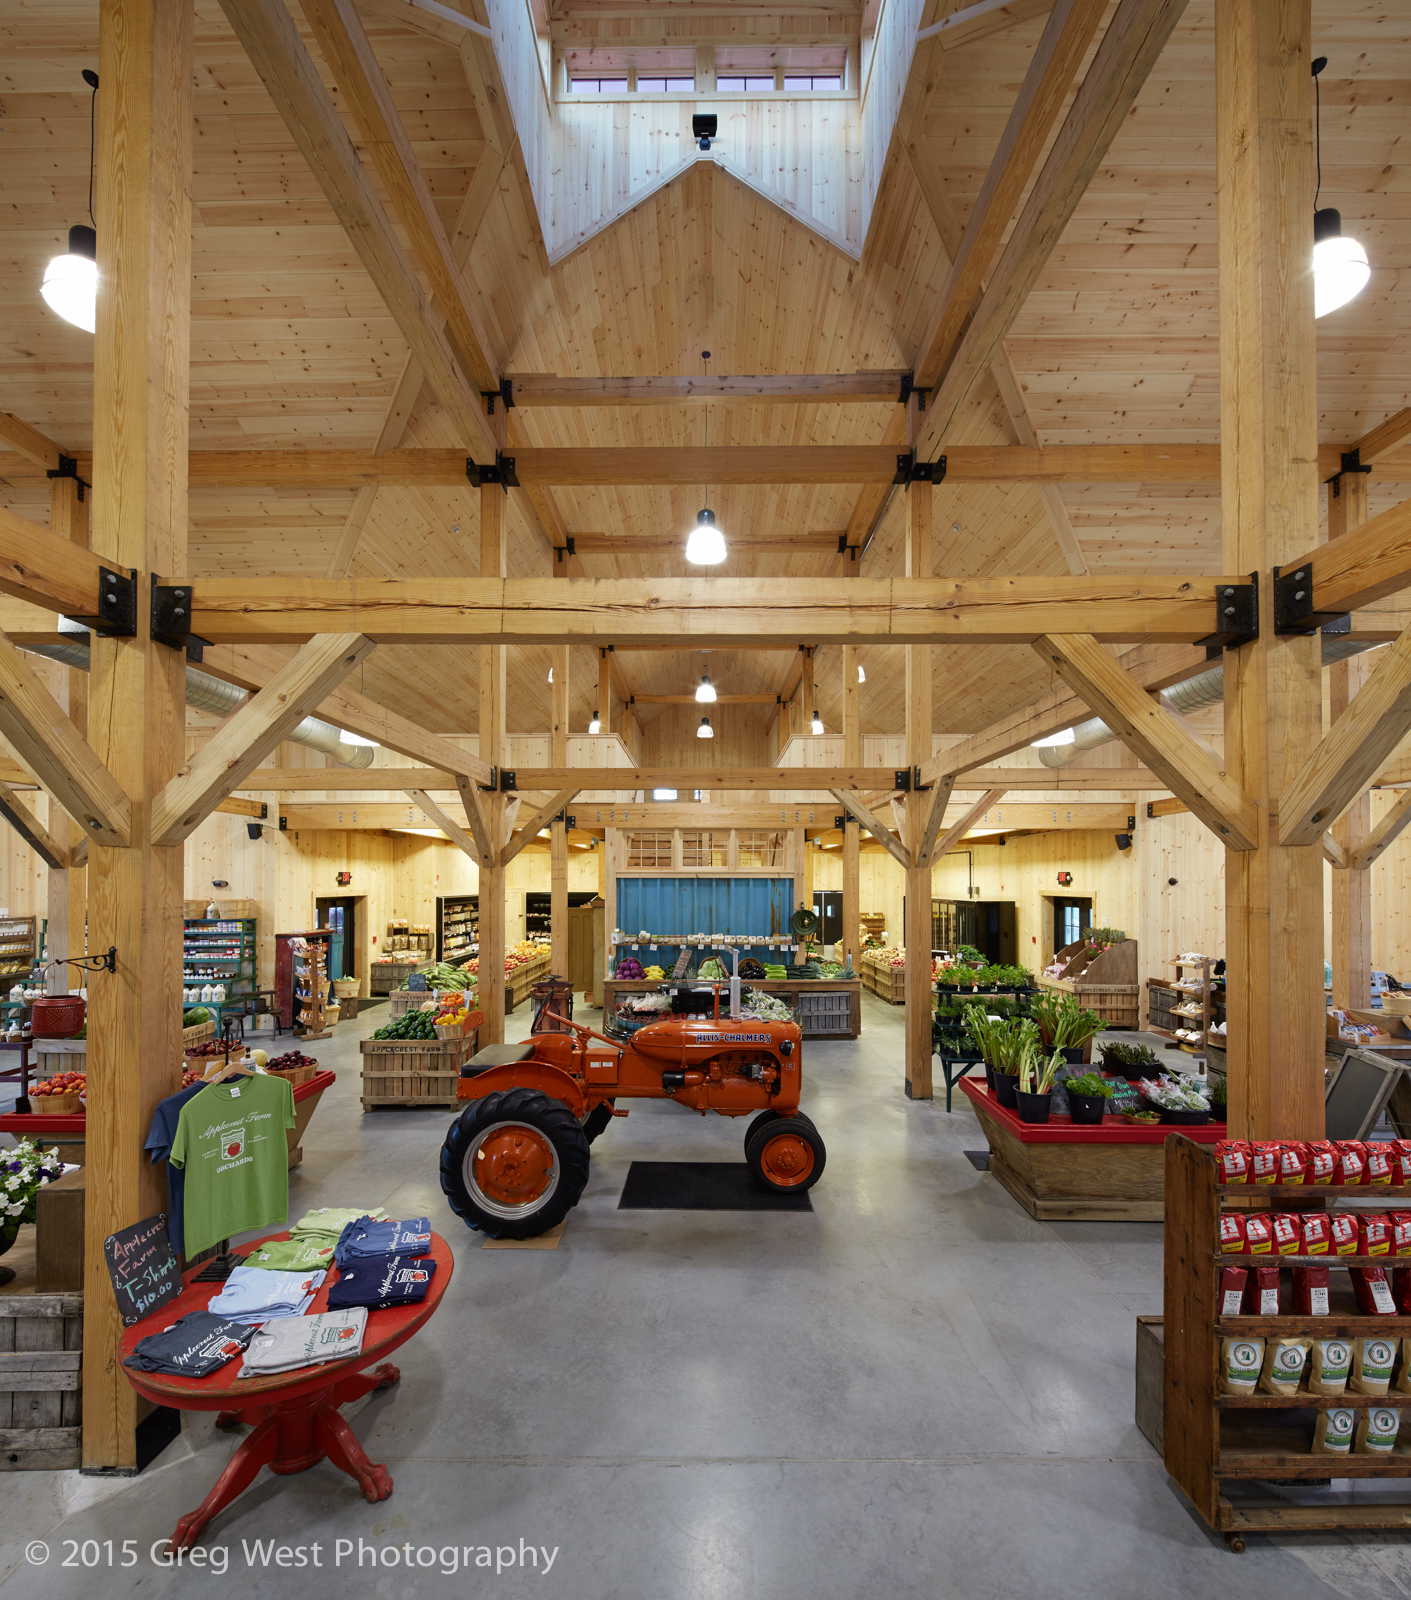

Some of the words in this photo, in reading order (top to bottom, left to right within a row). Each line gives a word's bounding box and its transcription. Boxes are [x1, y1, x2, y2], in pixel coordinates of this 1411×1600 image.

[696, 1033, 772, 1044] ALLIS-CHALMERS
[199, 1117, 245, 1139] Applecrest
[245, 1111, 271, 1123] Farm
[216, 1156, 254, 1174] ORCHARDS
[118, 1245, 157, 1279] Farm
[122, 1257, 177, 1302] T-Shirts
[135, 1281, 172, 1313] $10.00
